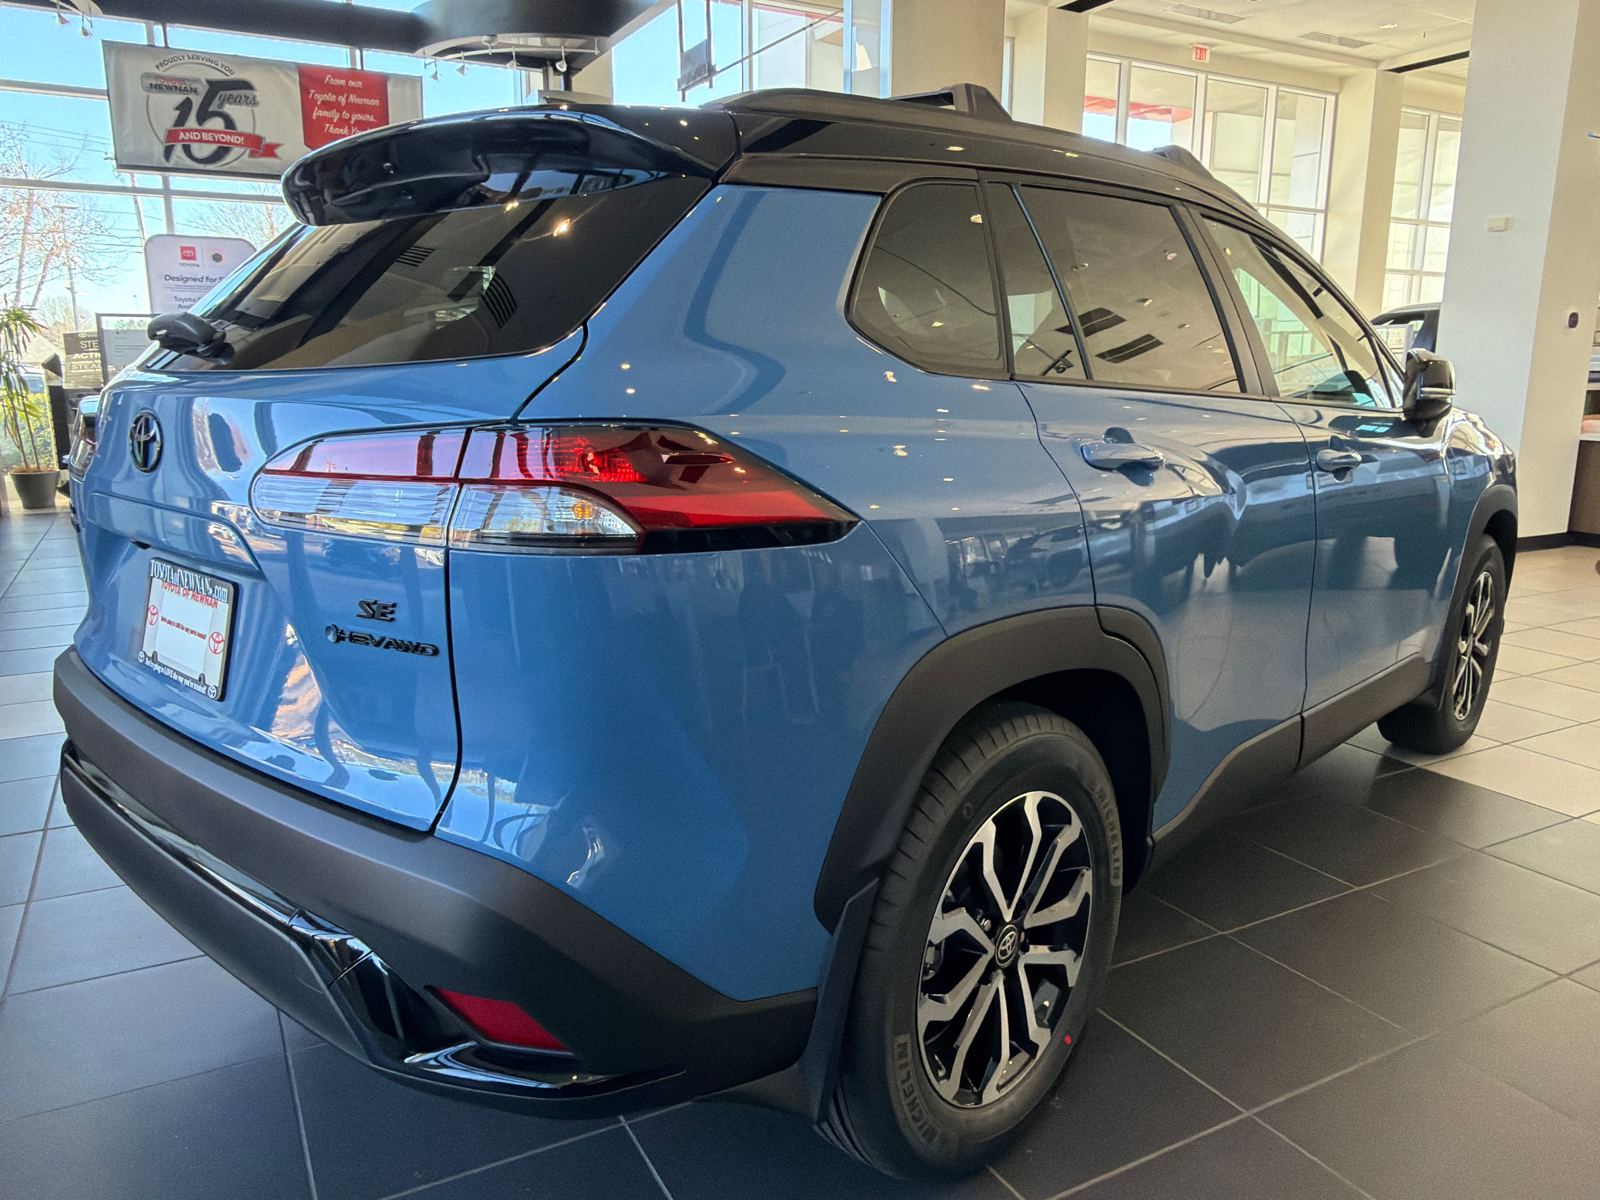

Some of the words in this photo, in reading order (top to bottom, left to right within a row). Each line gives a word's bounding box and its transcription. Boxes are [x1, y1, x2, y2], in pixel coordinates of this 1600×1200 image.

[1195, 46, 1208, 61] EXIT
[155, 54, 185, 70] PROUDLY
[186, 53, 219, 66] SERVING
[220, 63, 235, 75] YOU
[149, 83, 197, 93] NEWNAN
[154, 76, 186, 86] TOYOTA
[325, 75, 346, 86] From
[348, 80, 363, 88] our
[309, 90, 336, 105] Toyota
[338, 93, 347, 107] of
[348, 94, 380, 106] Newnan
[164, 79, 255, 164] 15
[217, 91, 258, 109] years
[313, 107, 340, 122] family
[342, 111, 349, 119] to
[350, 114, 377, 125] yours.
[324, 123, 350, 136] Thank
[179, 131, 201, 140] AND
[201, 133, 244, 145] BEYOND!
[164, 274, 204, 284] Designed
[205, 275, 217, 283] for
[173, 295, 196, 303] Toyota
[80, 339, 100, 349] STE
[161, 581, 181, 596] TOYOTA
[181, 587, 190, 599] OF
[191, 591, 218, 609] NEWNAN
[356, 599, 398, 622] SE
